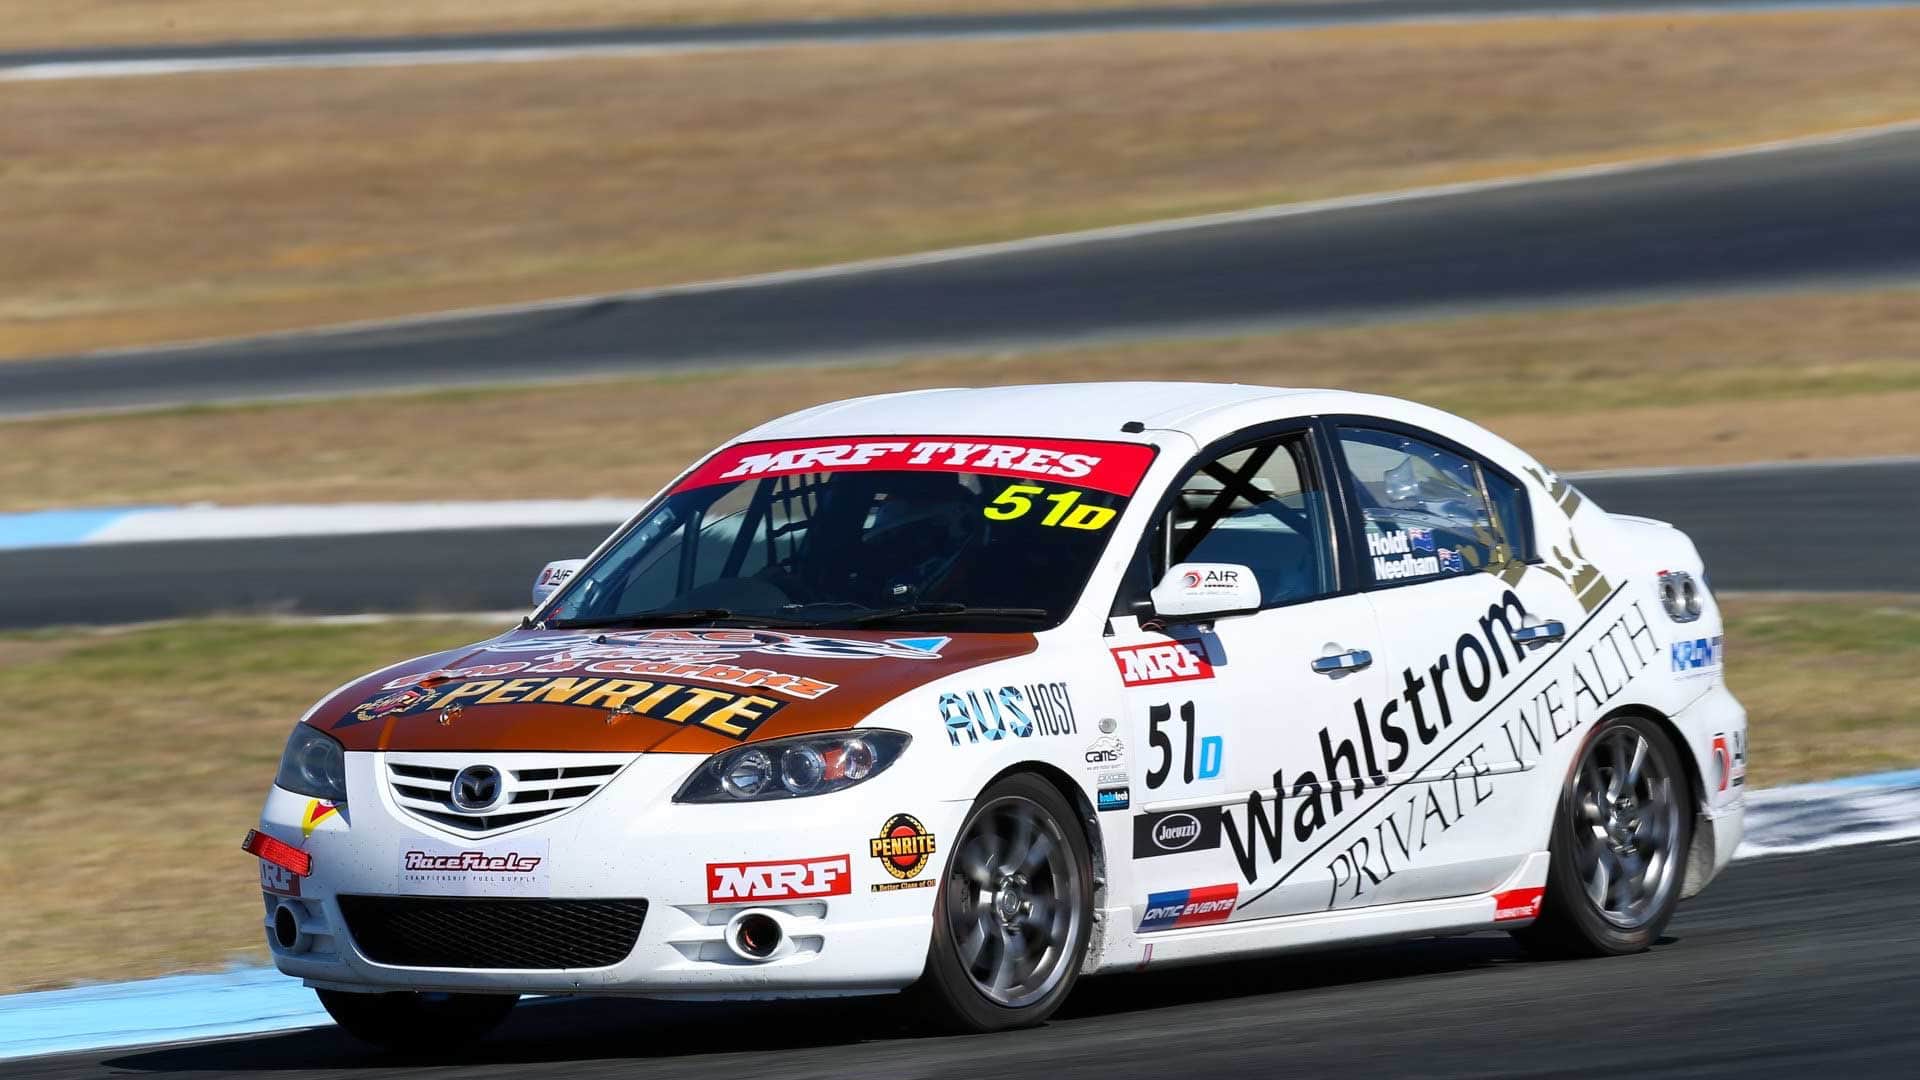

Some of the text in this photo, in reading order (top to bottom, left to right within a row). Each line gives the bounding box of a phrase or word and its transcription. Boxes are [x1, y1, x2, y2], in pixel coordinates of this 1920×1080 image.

[720, 442, 1101, 479] MRF TYRES
[1366, 530, 1410, 556] Holdt
[1204, 570, 1238, 582] AIR
[1373, 553, 1439, 580] Needham
[1117, 643, 1204, 682] MRF
[427, 676, 778, 737] PENRITE
[1220, 589, 1527, 885] Wahlstrom
[1327, 600, 1662, 908] PRIVATE WEALTH
[1159, 821, 1195, 841] Jacuzzi
[871, 834, 936, 857] PENRITE
[405, 851, 541, 872] RaceFuels
[712, 859, 847, 898] MRF
[1183, 898, 1235, 916] EVENTS
